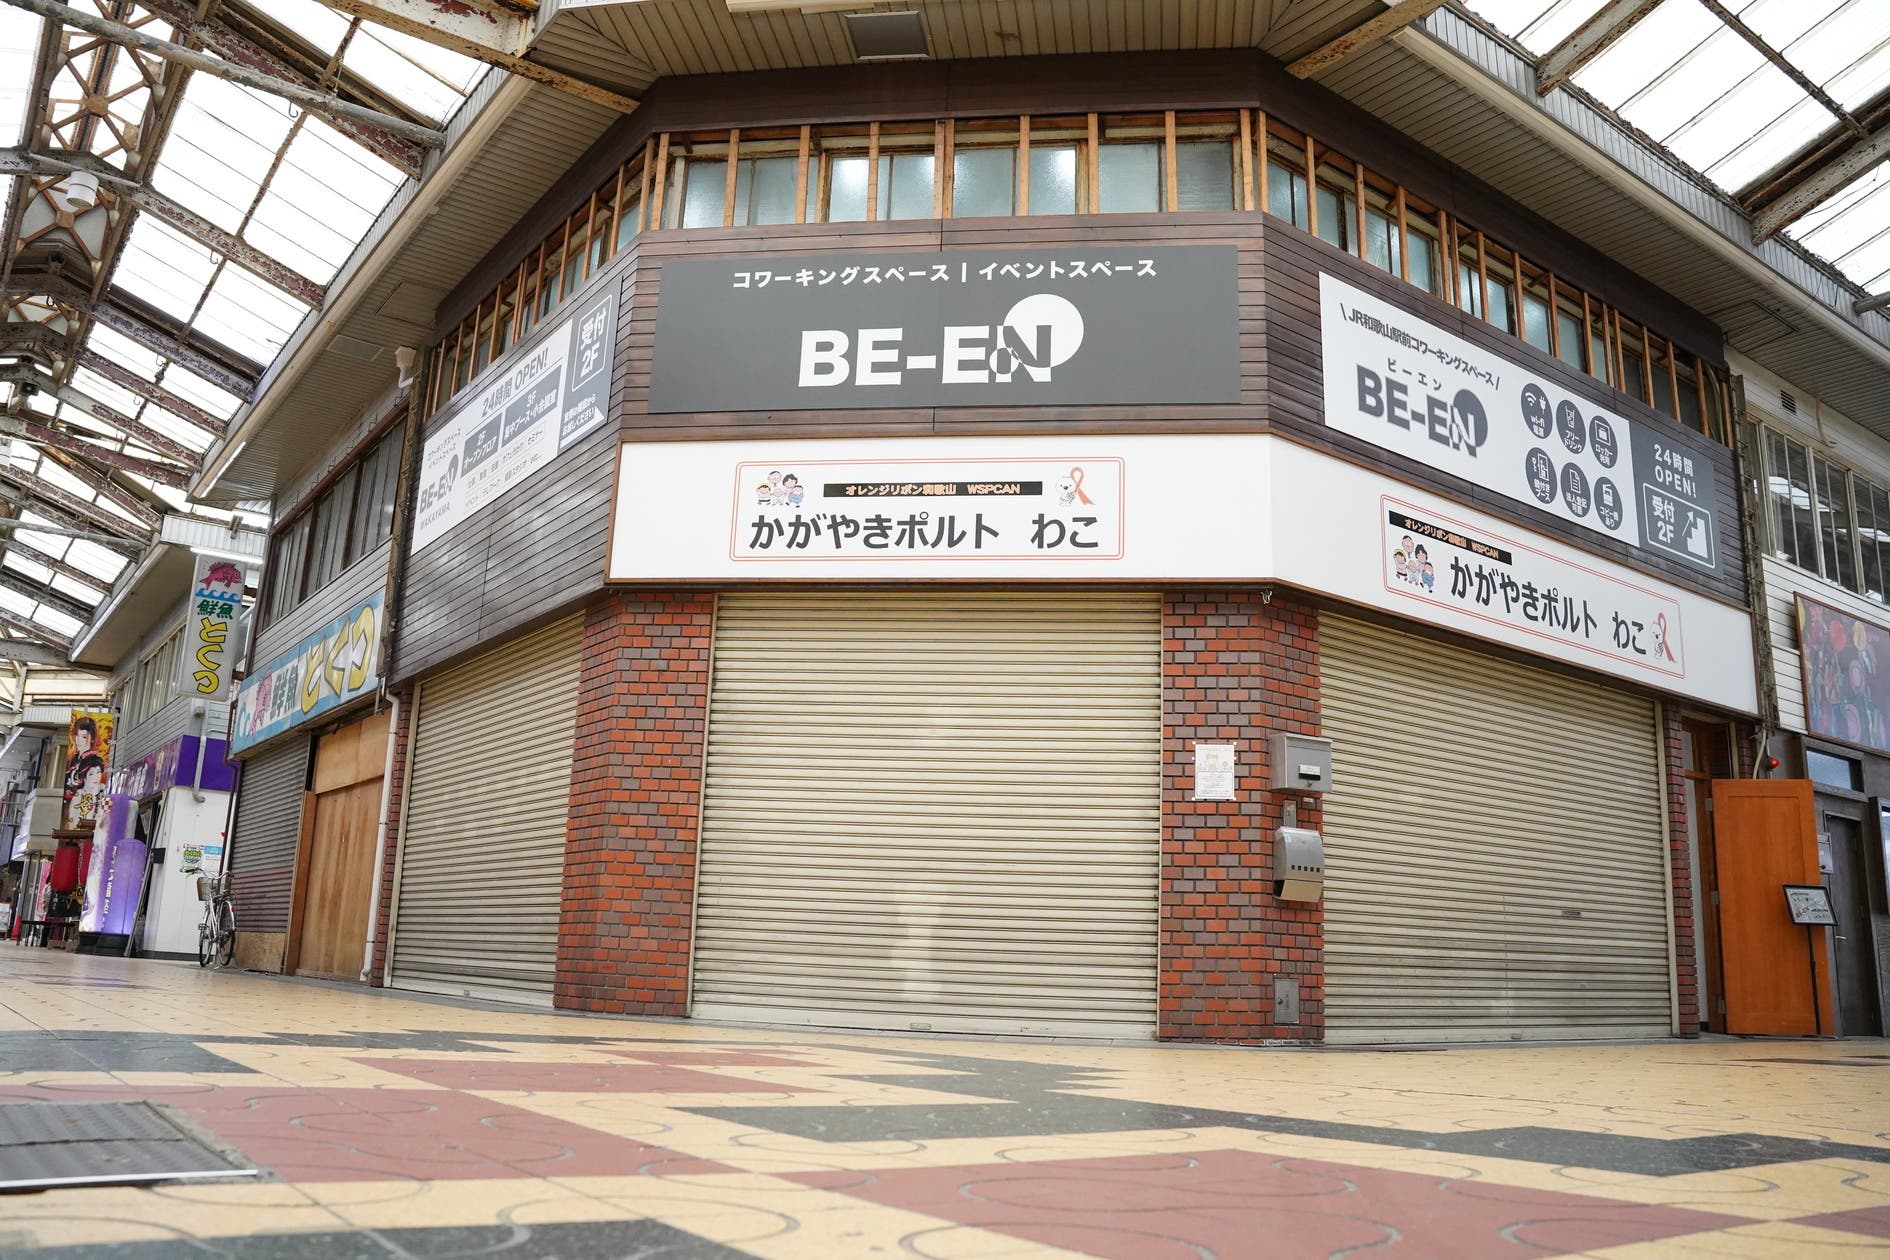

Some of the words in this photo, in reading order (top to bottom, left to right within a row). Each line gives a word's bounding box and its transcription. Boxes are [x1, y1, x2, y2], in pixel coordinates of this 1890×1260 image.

[733, 263, 950, 289] コワーキングスペース
[979, 258, 1157, 282] イベントスペース
[580, 307, 607, 350] 受付
[580, 342, 600, 378] 2F
[799, 324, 1053, 388] BE-EN
[482, 377, 513, 418] 24時間
[514, 347, 548, 391] OPEN!
[1388, 357, 1442, 391] ビーエン
[1356, 363, 1477, 458] BE-EN
[1564, 438, 1583, 452] ドリンク
[1654, 444, 1693, 477] 24時間
[845, 482, 957, 496] オレンジリボン和歌山
[967, 483, 1020, 495] WSPCAN
[1655, 465, 1696, 498] OPEN!
[1652, 494, 1675, 523] 受付
[749, 511, 999, 549] かがやきポルト
[1031, 512, 1099, 550] わこ
[1657, 520, 1674, 543] 2F
[197, 599, 233, 620] 鮮魚
[1450, 555, 1598, 639] かがやきポルト
[1611, 611, 1647, 655] わこ
